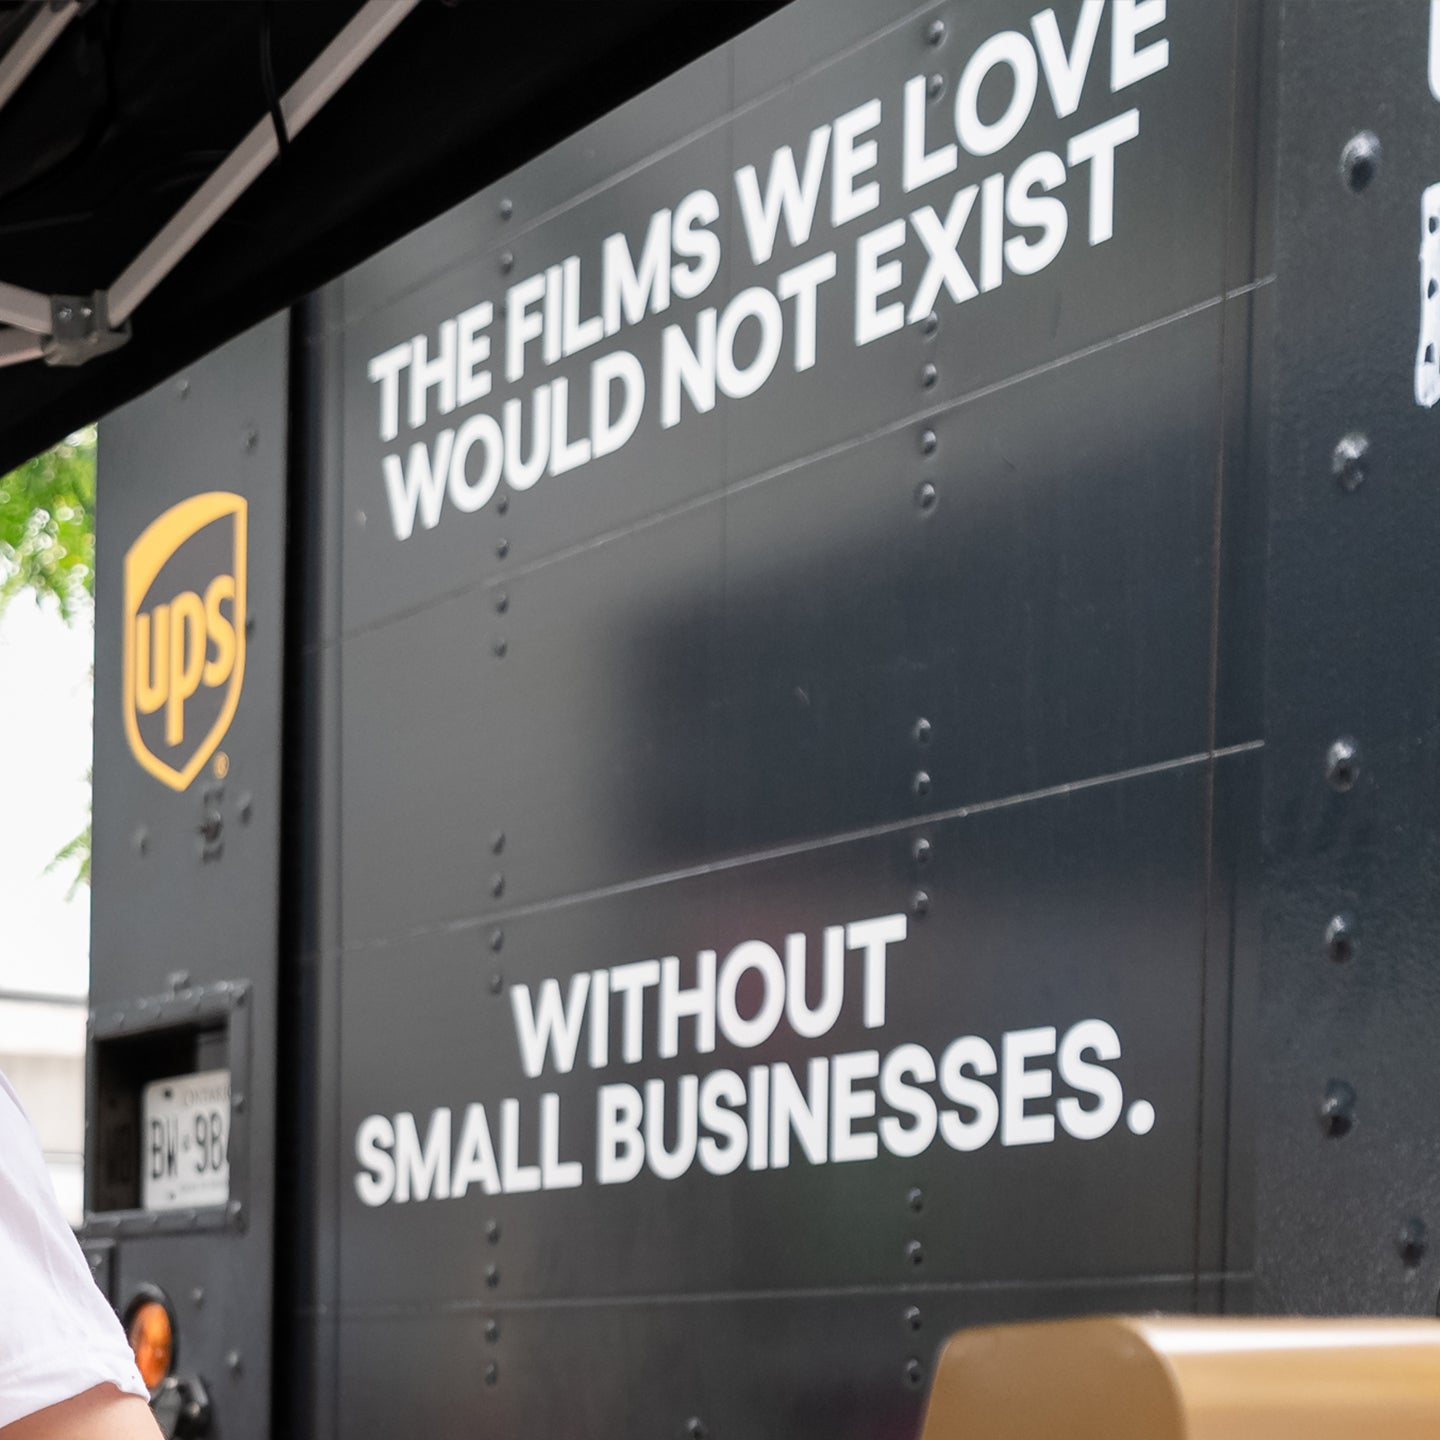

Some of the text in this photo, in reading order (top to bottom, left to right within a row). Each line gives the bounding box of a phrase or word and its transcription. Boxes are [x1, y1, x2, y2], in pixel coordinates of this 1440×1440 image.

[368, 0, 1169, 442] THE FILMS WE LOVE
[383, 108, 1140, 541] WOULD NOT EXIST
[355, 1019, 1155, 1206] SMALL BUSINESSES.
[511, 914, 907, 1078] WITHOUT
